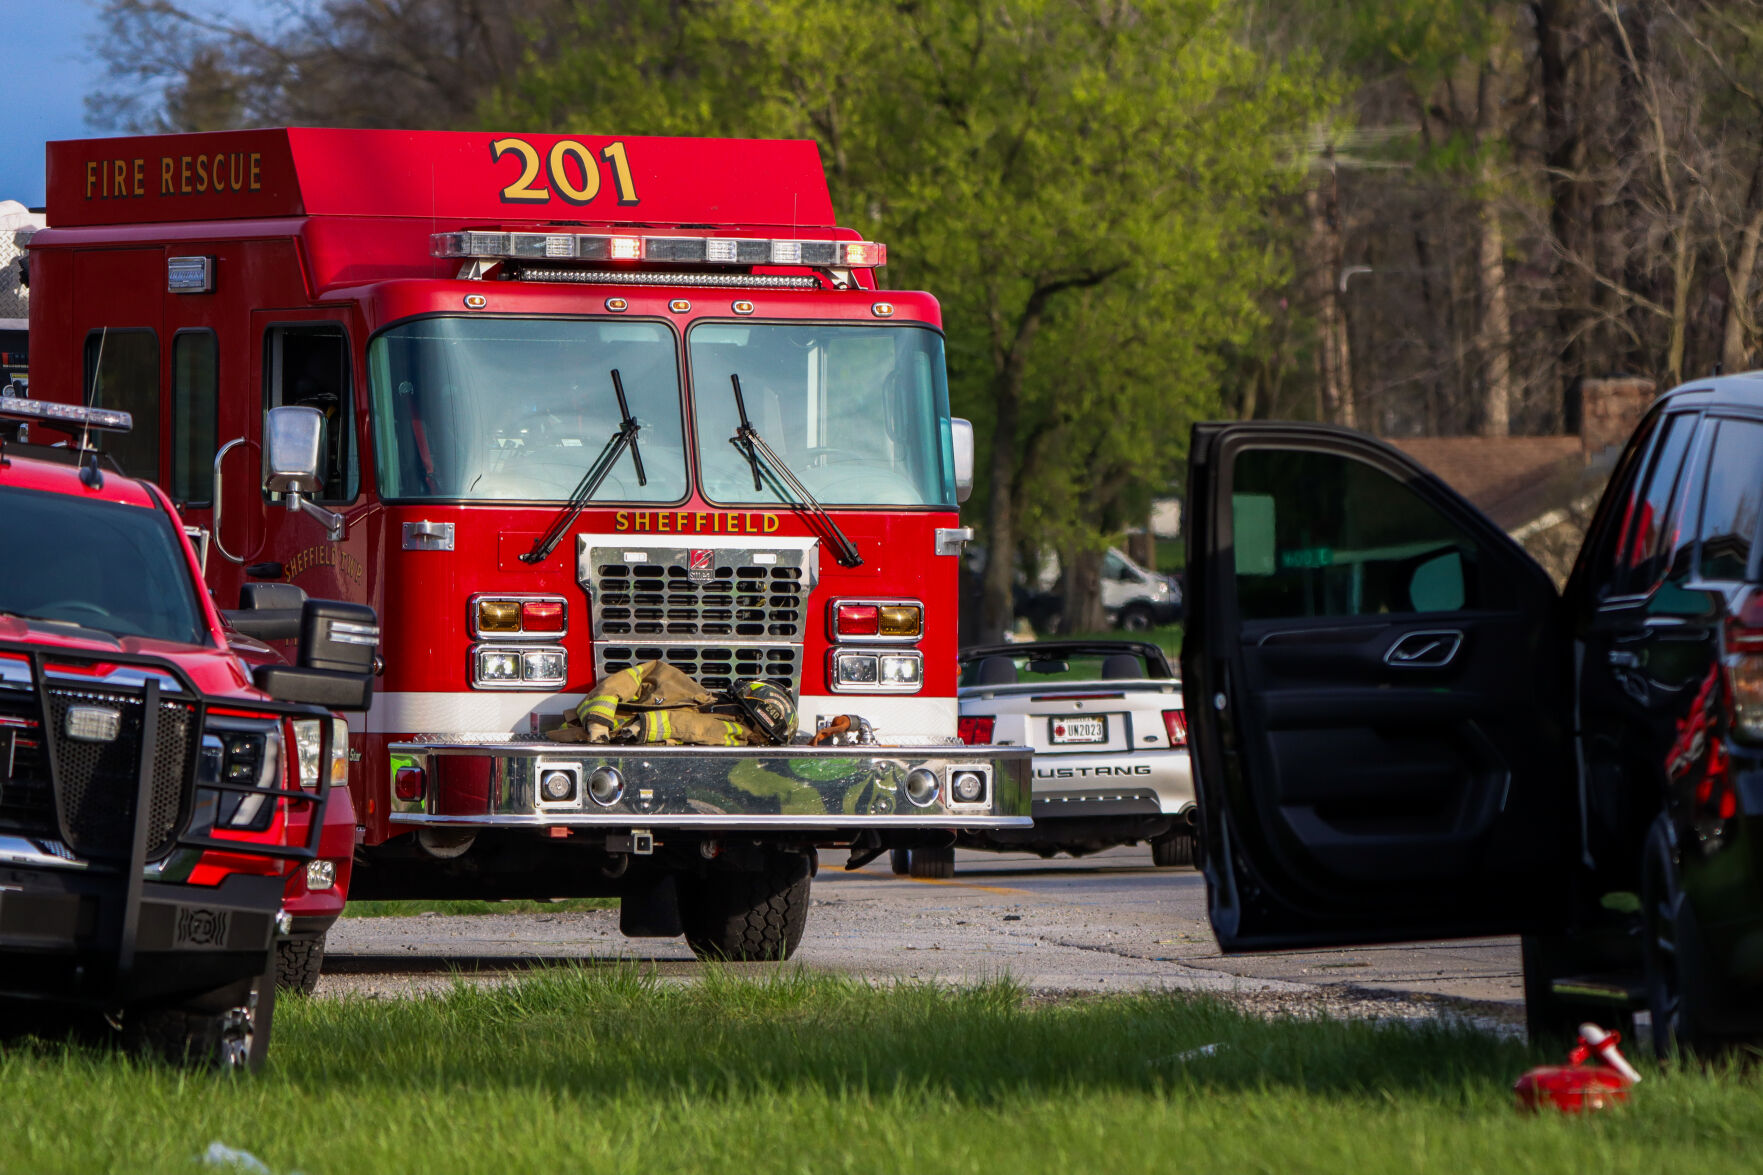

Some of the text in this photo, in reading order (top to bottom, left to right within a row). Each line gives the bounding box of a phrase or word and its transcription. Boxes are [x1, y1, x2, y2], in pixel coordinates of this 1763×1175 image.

[86, 152, 261, 200] FIRE RESCUE
[489, 137, 640, 207] 201
[615, 511, 780, 533] SHEFFIELD
[284, 545, 336, 584] SHEFFIELD
[1032, 765, 1152, 779] USTANG
